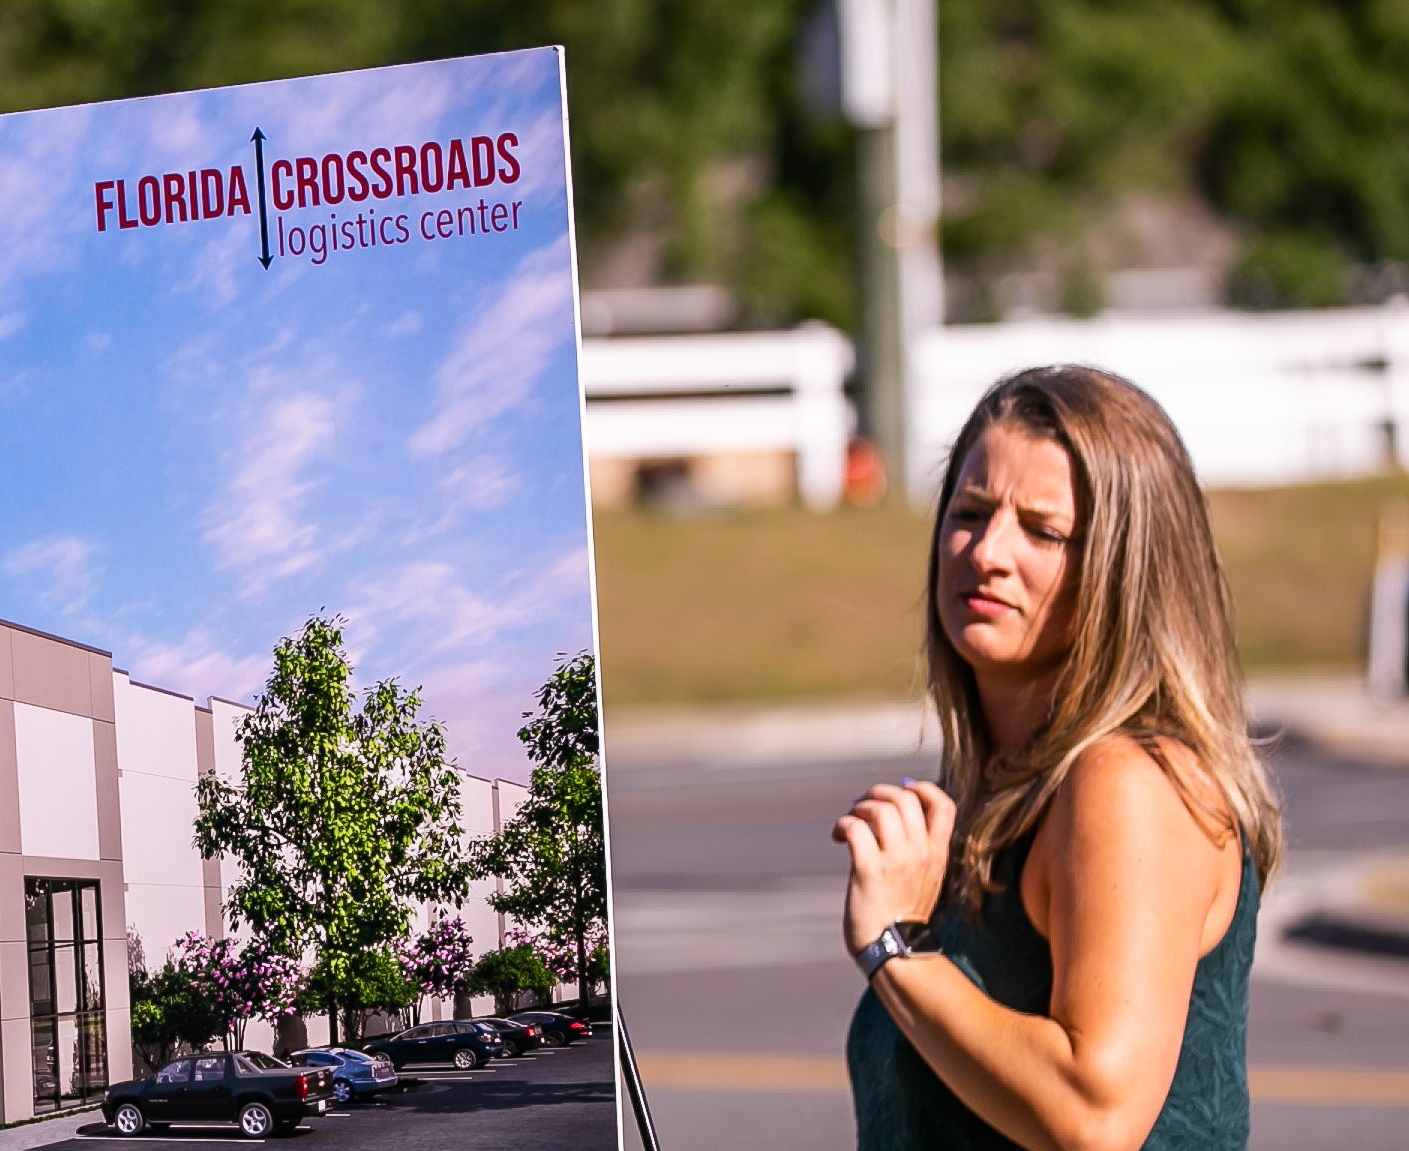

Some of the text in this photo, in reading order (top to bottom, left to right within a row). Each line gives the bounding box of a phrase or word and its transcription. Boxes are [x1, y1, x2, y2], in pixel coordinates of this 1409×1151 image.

[95, 132, 521, 232] FLORIDA CROSSROADS
[277, 200, 523, 265] logistics center
